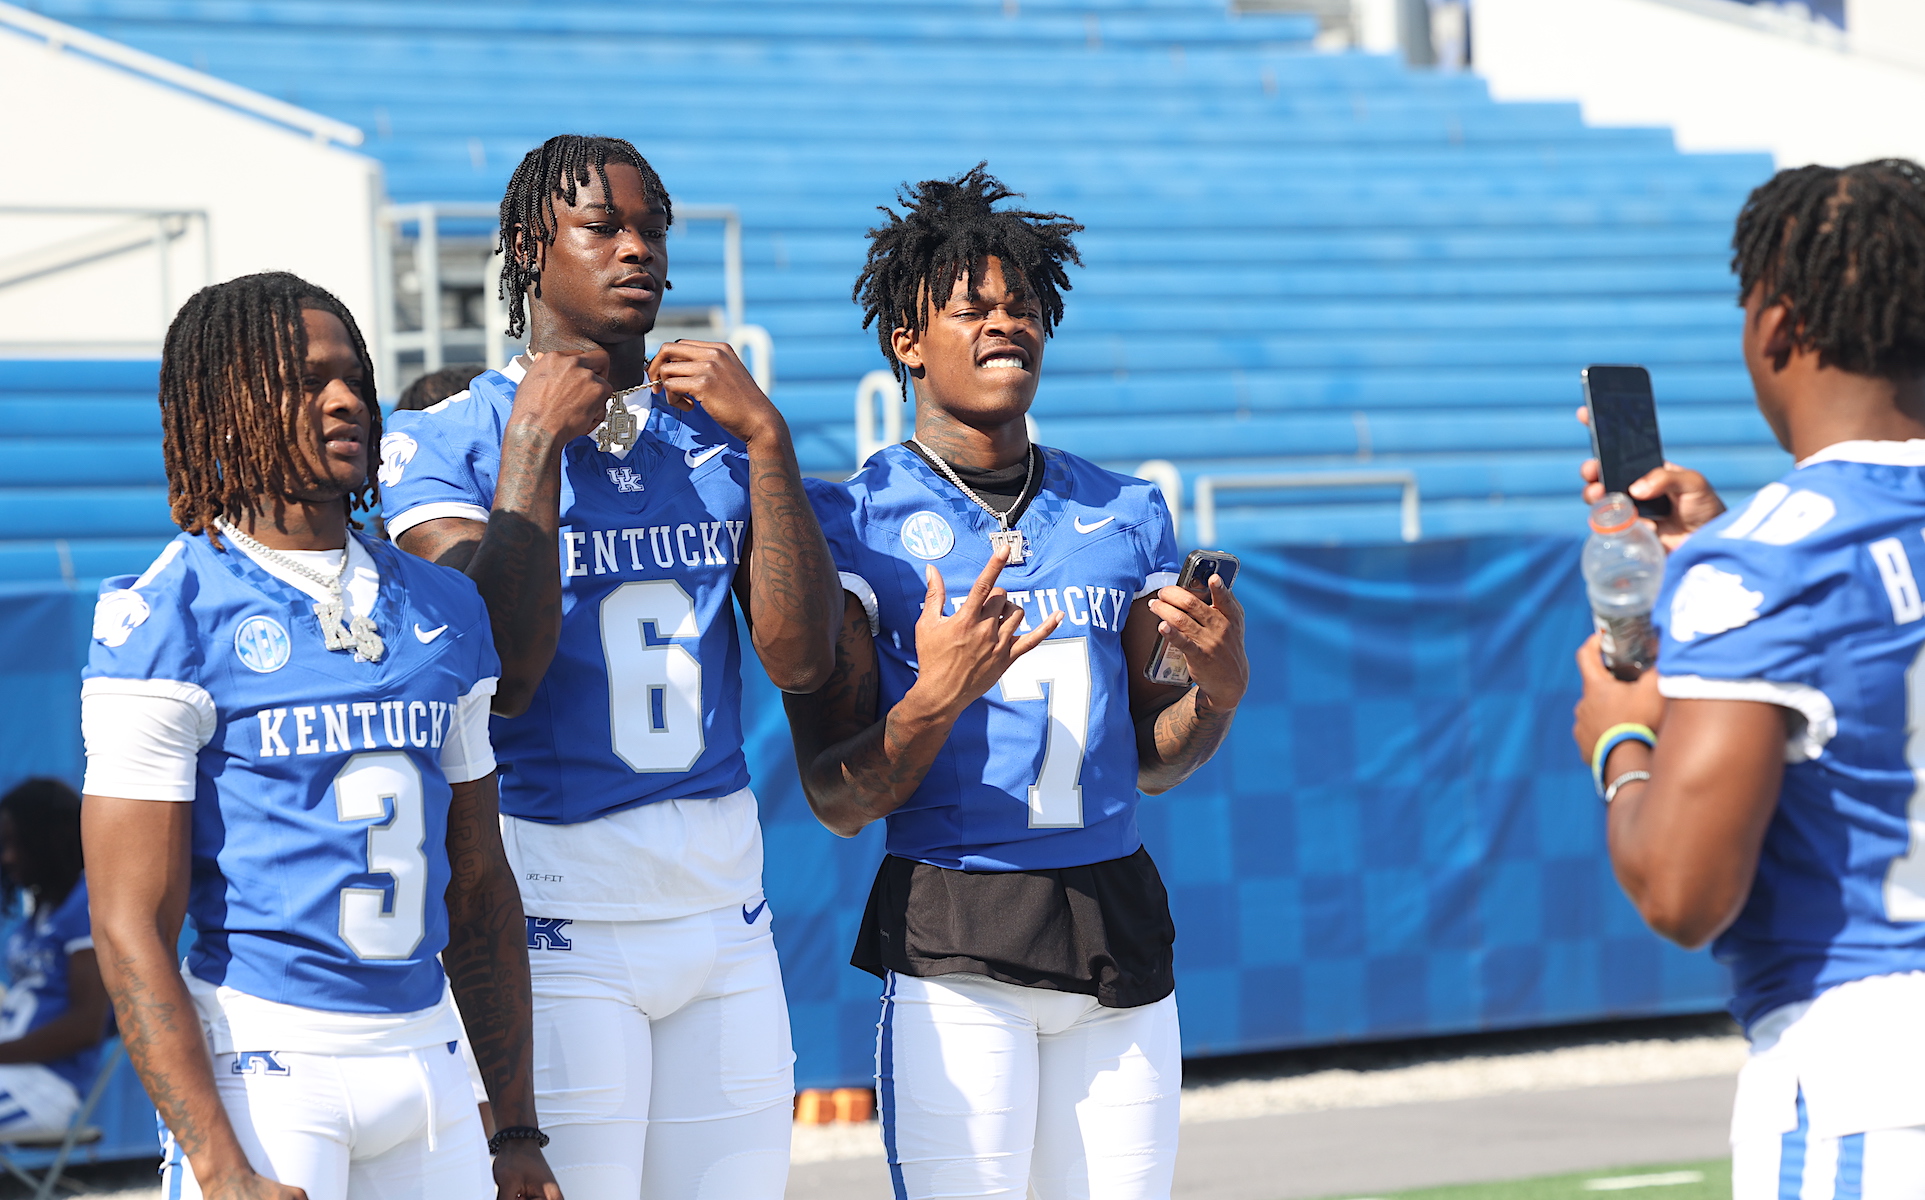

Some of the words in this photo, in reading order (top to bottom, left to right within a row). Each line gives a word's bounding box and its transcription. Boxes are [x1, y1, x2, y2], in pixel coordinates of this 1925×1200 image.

[606, 467, 645, 493] UK
[564, 520, 745, 577] ENTUCKY
[905, 515, 949, 555] SEC
[1868, 536, 1925, 626] B
[238, 618, 285, 670] SEC
[598, 578, 707, 774] 6
[997, 636, 1093, 830] 7
[332, 750, 428, 960] 3
[525, 873, 564, 883] DRI-FIT
